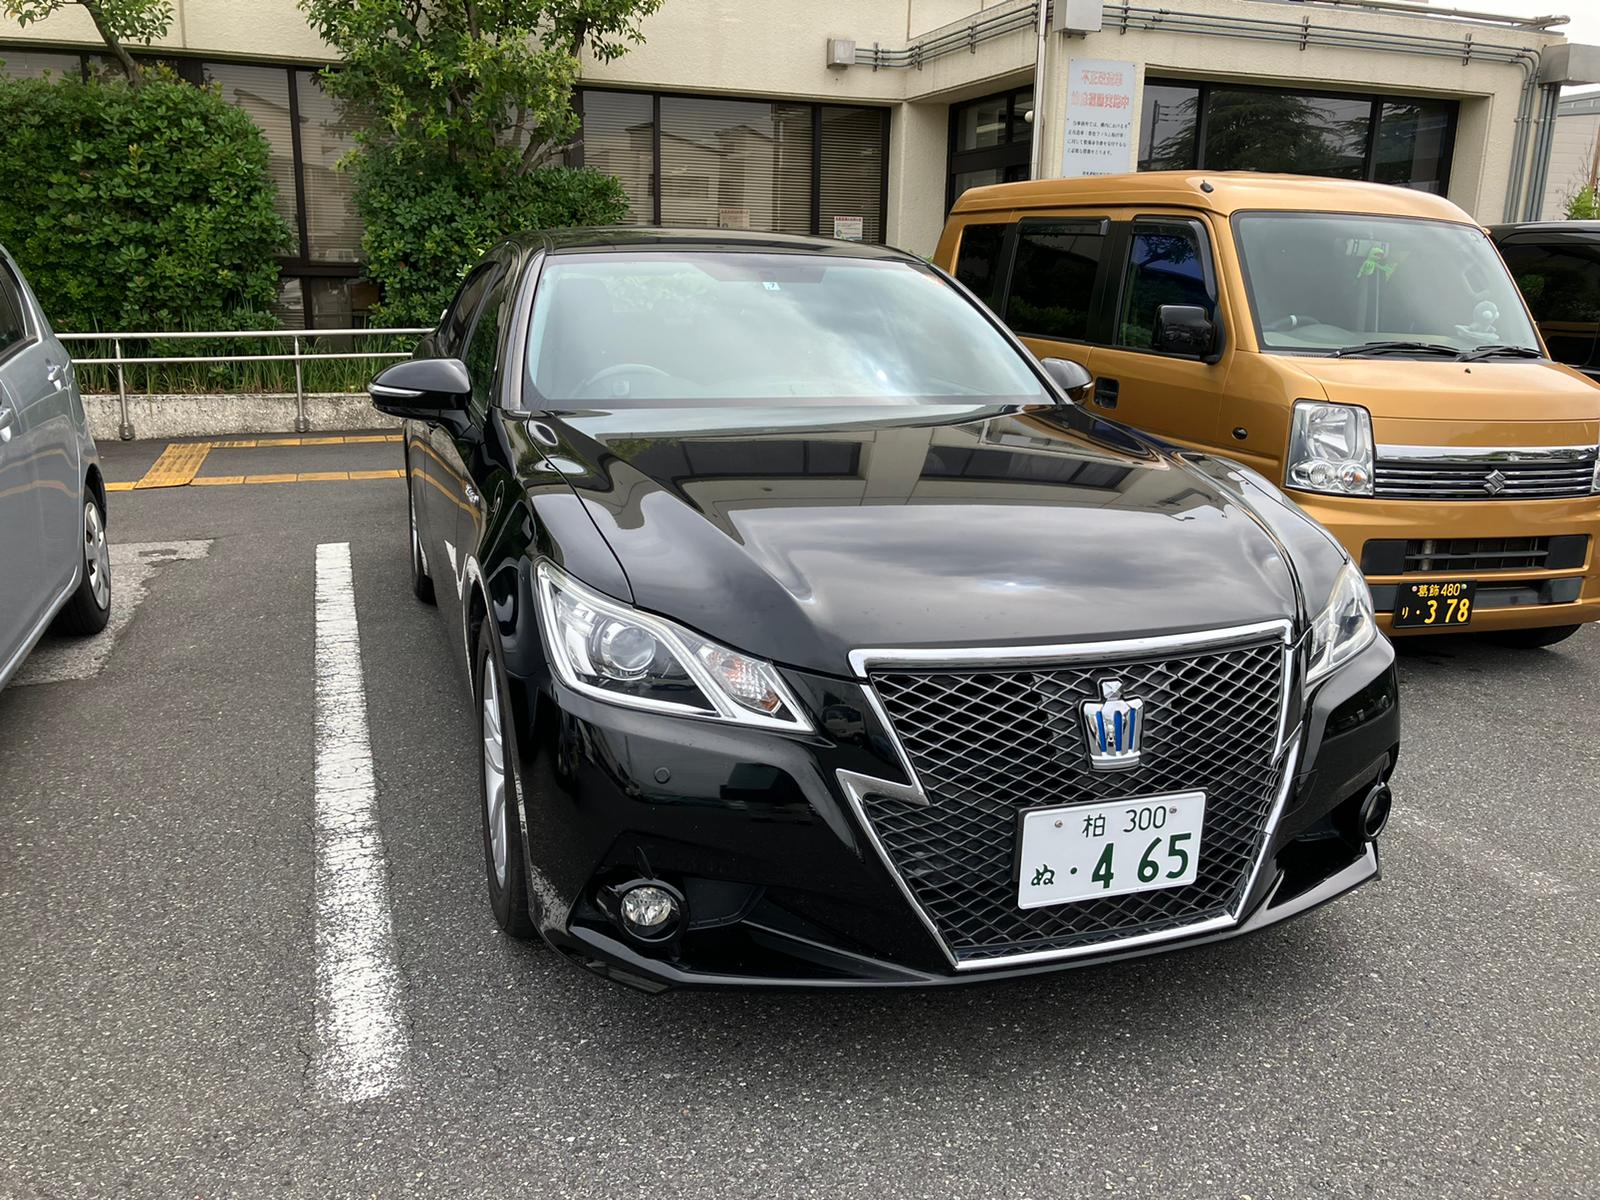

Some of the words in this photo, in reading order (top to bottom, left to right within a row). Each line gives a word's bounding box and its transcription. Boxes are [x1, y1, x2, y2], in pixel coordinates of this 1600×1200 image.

[1417, 584, 1440, 597] 葛飾
[1440, 583, 1460, 597] 480
[1082, 813, 1106, 838] 柏
[1123, 806, 1166, 833] 300
[1031, 864, 1055, 886] ぬ
